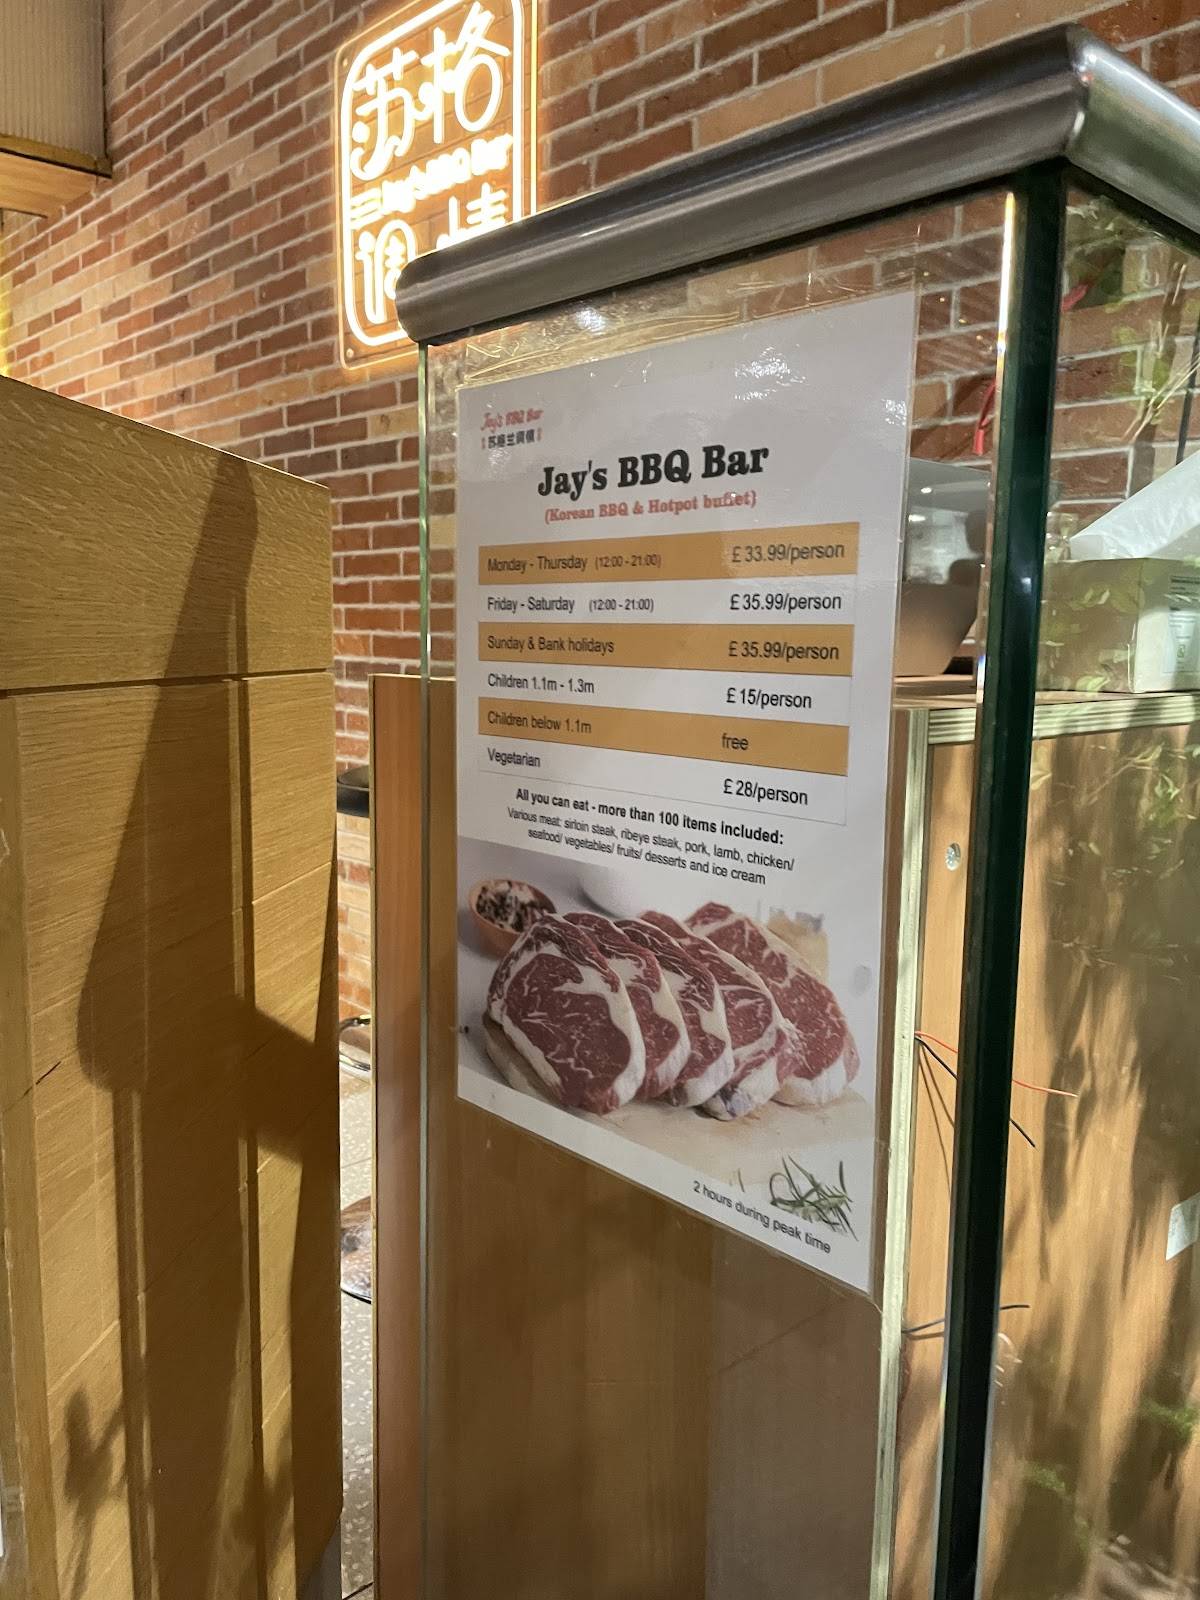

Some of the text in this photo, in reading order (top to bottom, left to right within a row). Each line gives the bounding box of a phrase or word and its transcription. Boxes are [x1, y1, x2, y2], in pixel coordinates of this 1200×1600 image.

[537, 444, 769, 501] Jay's BBQ Bar
[545, 490, 757, 524] (Korean BBQ & Hotpot buffet)
[487, 558, 528, 574] Monday
[537, 555, 588, 572] Thursday
[487, 597, 518, 614] Friday
[527, 597, 575, 613] Saturday
[487, 636, 525, 653] Sunday
[527, 637, 535, 650] &
[538, 637, 566, 651] Bank
[568, 638, 615, 656] holidays
[487, 673, 528, 689] Children
[532, 676, 557, 691] 1.1m
[568, 678, 595, 693] 1.3m
[487, 711, 749, 751] Children below 1.1m free
[487, 747, 541, 767] Vegetarian
[516, 788, 529, 801] All
[531, 792, 550, 805] you
[551, 796, 570, 808] can
[572, 799, 590, 811] eat
[598, 803, 626, 818] more
[629, 806, 655, 823] than
[659, 811, 679, 826] 100
[682, 814, 717, 833] items
[720, 820, 784, 844] included:
[507, 806, 538, 823] Various
[564, 818, 590, 833] sirloin
[620, 828, 650, 845] ribeye
[652, 834, 682, 852] steak,
[684, 841, 711, 857] pork,
[713, 844, 744, 863] lamb,
[746, 851, 795, 871] chicken/
[528, 828, 767, 885] seafood/ vegetables/ fruits/ desserts and ice cream
[693, 1180, 832, 1254] 2 hours during peak time
